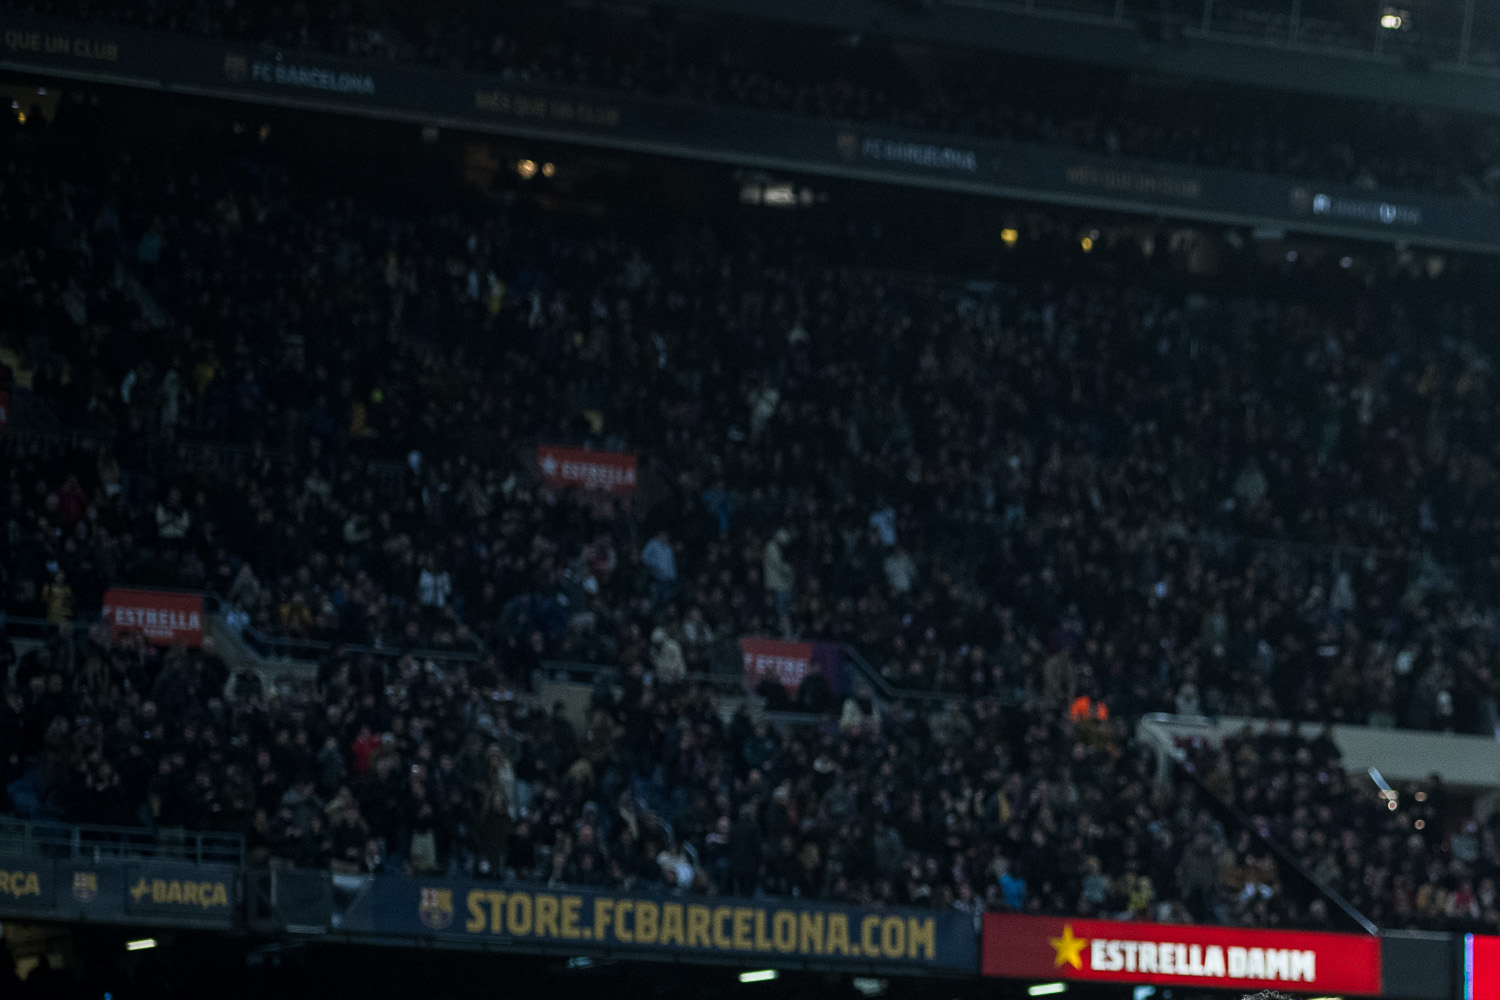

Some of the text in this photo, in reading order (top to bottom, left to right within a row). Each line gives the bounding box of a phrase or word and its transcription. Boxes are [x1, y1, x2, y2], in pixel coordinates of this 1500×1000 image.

[252, 61, 272, 83] FC
[114, 605, 200, 631] ESTRELLA
[465, 890, 937, 960] STORE.FCBARCELONA.COM
[1090, 938, 1317, 983] ESTRELLA DAMM
